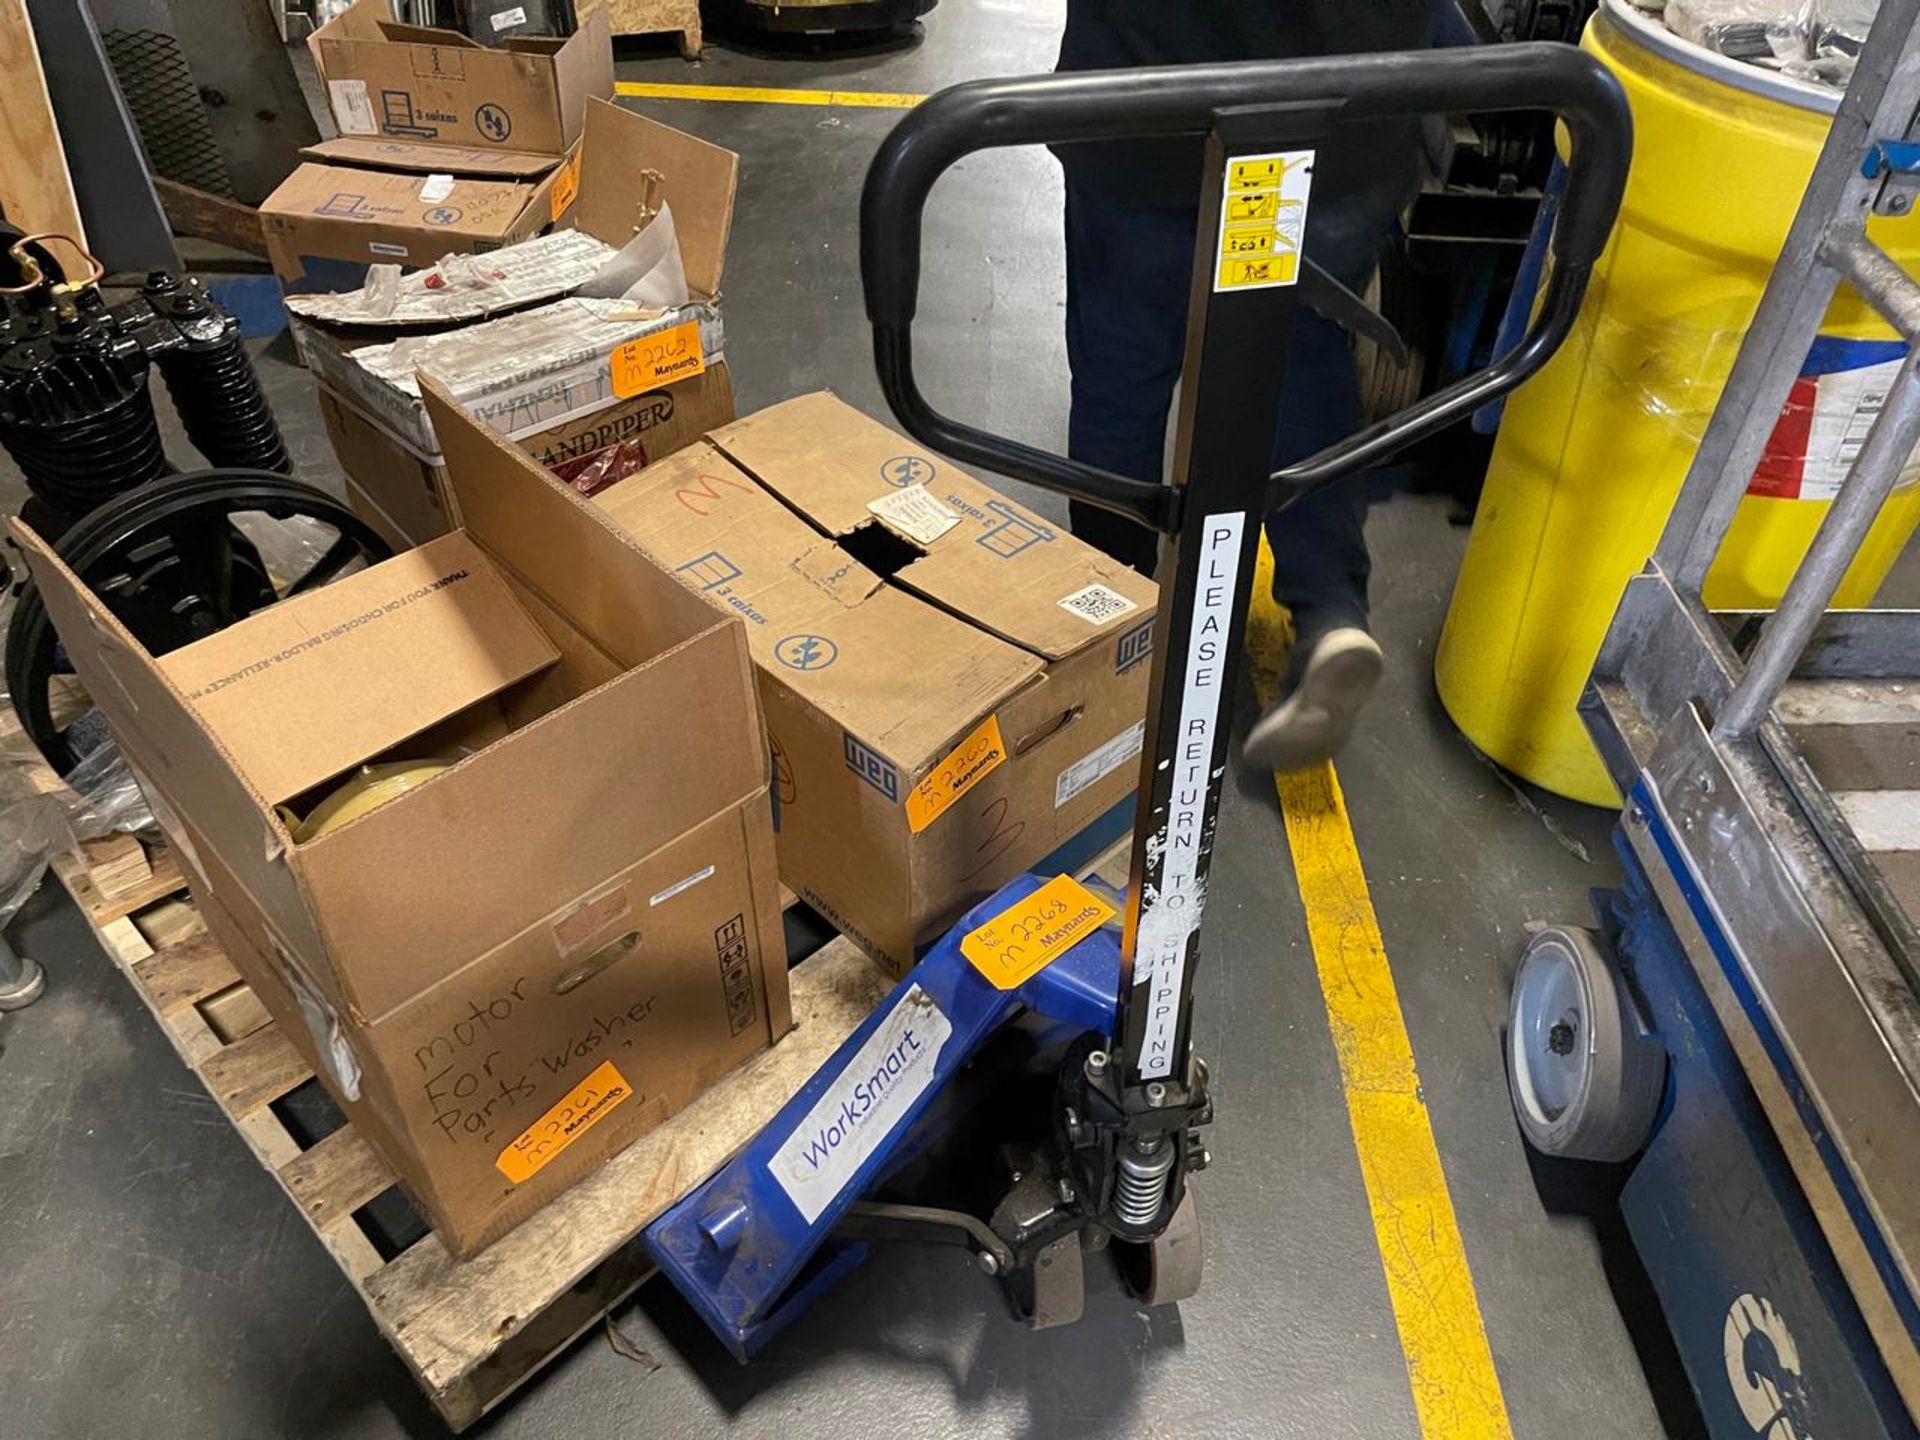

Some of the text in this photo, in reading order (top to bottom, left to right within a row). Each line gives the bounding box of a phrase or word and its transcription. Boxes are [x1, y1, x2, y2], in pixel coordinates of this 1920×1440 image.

[654, 355, 700, 376] Maynards
[532, 401, 668, 467] ANDPIPER
[407, 586, 432, 603] YOU
[431, 569, 469, 591] THANK
[322, 608, 384, 642] CHOOSING
[383, 598, 407, 614] FOR
[716, 585, 769, 625] 3 caixas
[951, 749, 1000, 791] Maynards
[1148, 528, 1232, 1070] PLEASE RETURN TO SHIPPING
[975, 927, 996, 943] Lot
[1039, 905, 1101, 948] Maynards
[424, 1051, 502, 1113] For
[802, 1029, 921, 1170] WorkSmart
[432, 1074, 537, 1143] Parts
[563, 1086, 624, 1135] Maynards
